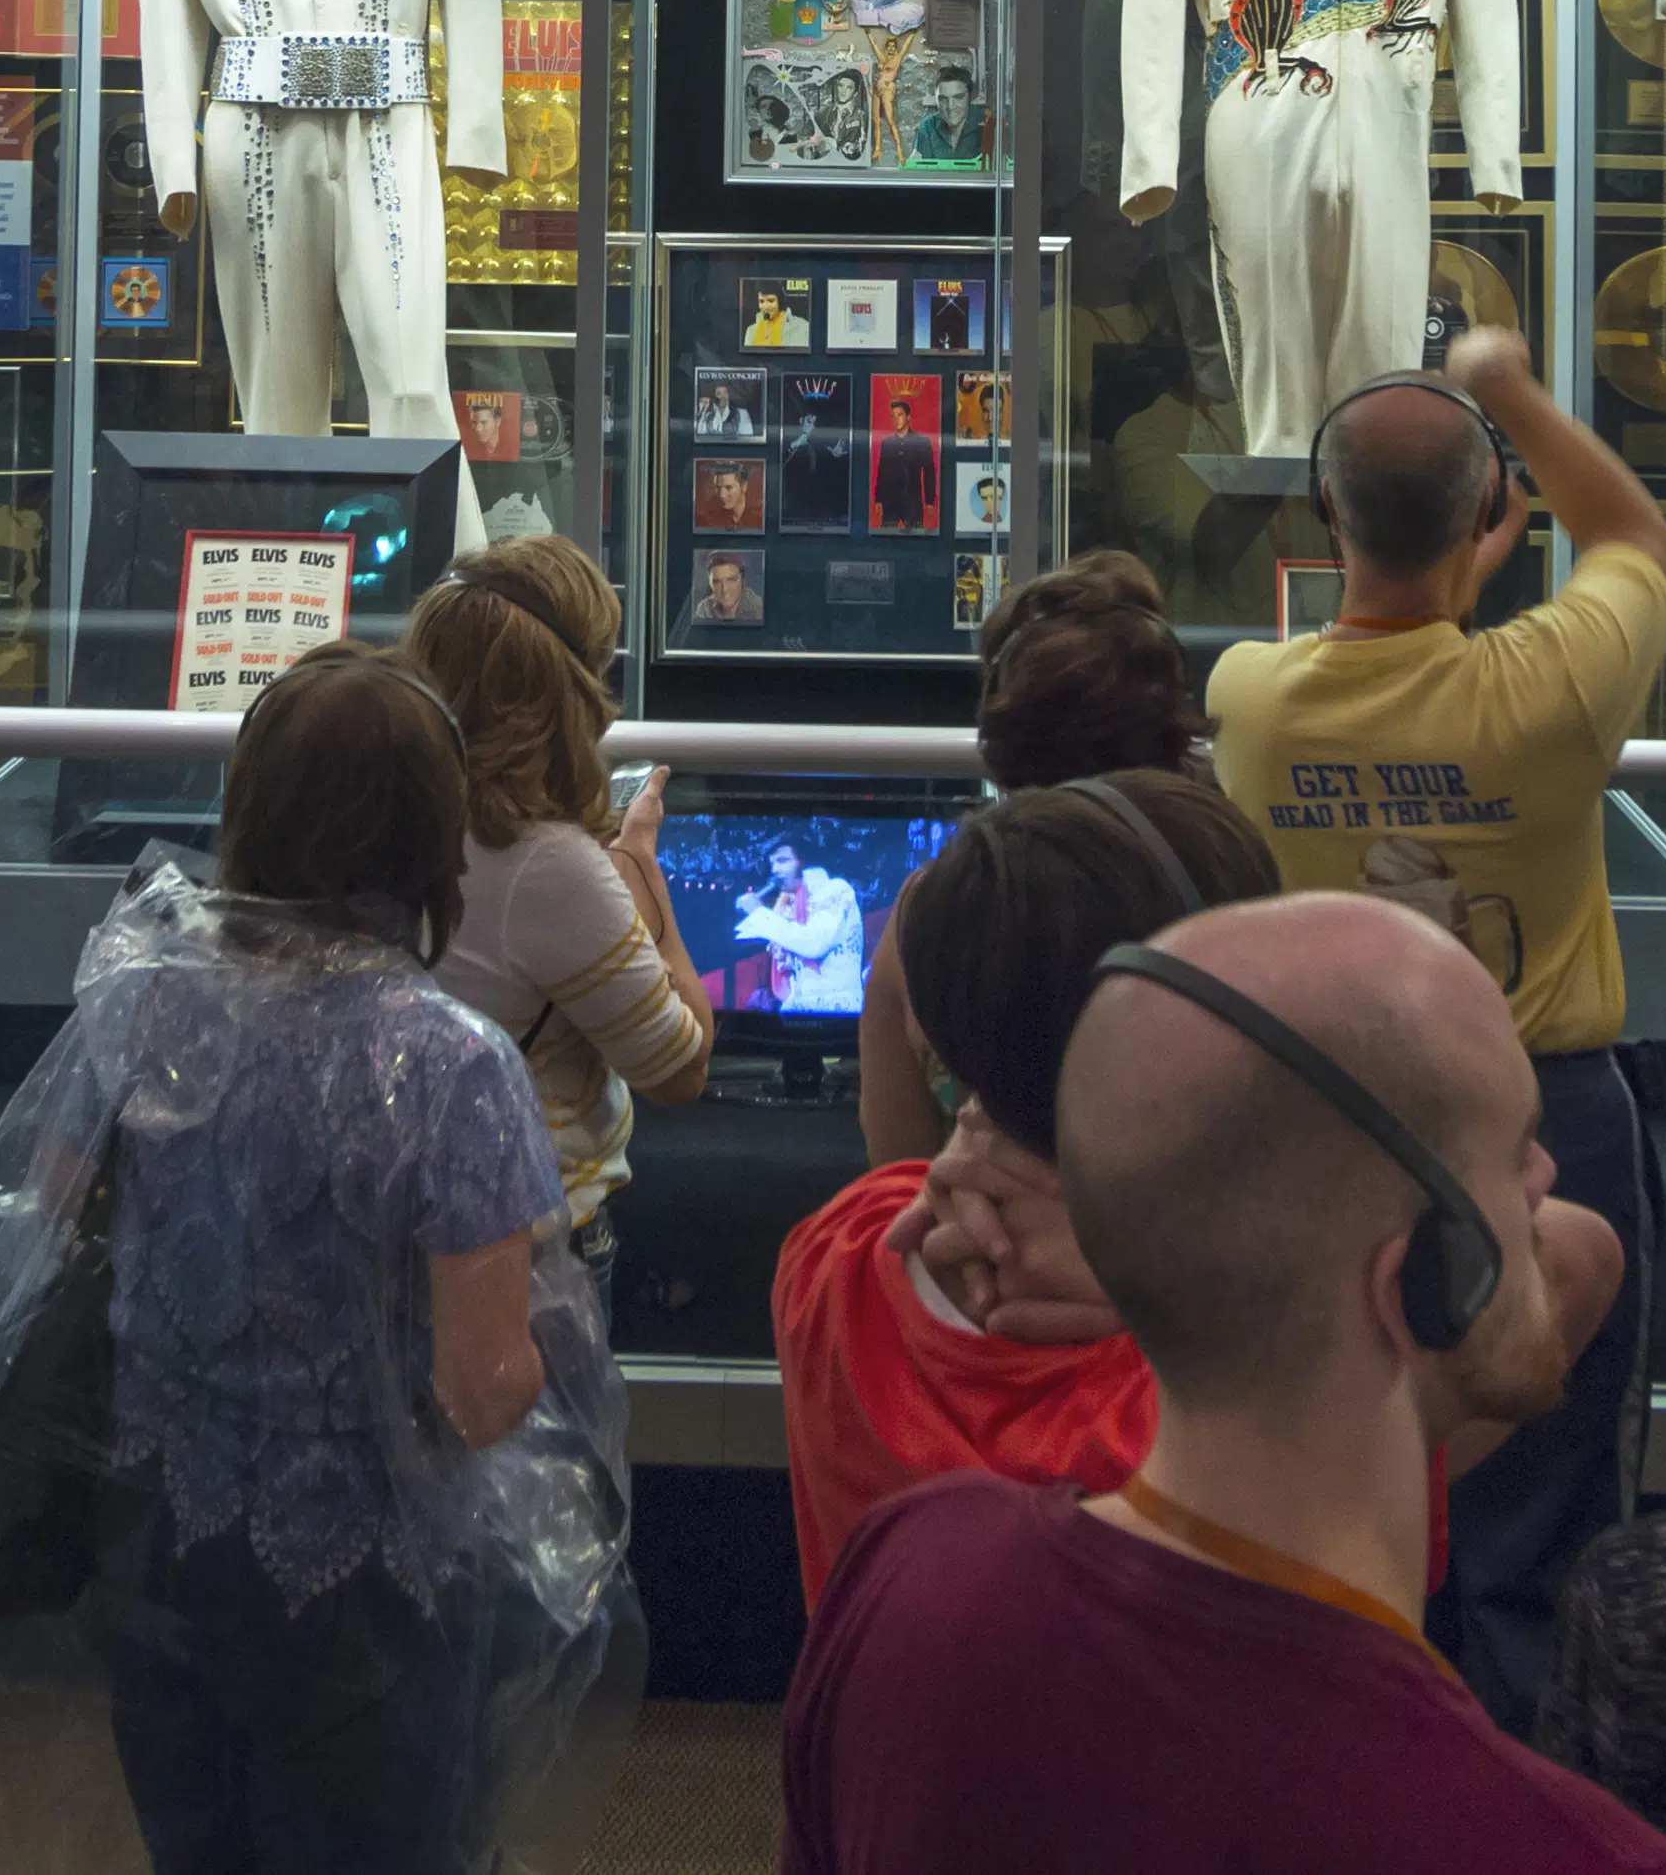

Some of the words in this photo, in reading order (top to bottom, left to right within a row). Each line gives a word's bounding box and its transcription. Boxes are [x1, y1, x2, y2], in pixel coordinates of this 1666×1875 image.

[502, 18, 581, 72] ELVIS
[937, 280, 963, 293] ELVIS
[728, 372, 763, 381] CONCERT
[796, 377, 837, 396] ELVIS
[465, 393, 504, 406] PRESLEY
[202, 548, 239, 565] ELVIS
[250, 548, 288, 563] ELVIS
[299, 550, 337, 569] ELVIS
[203, 592, 222, 605] SOLD
[223, 591, 239, 603] OUT
[247, 591, 265, 602] SOLD
[266, 592, 283, 603] OUT
[289, 593, 308, 606] SOLD
[309, 596, 326, 608] OUT
[196, 609, 232, 626] ELVIS
[245, 608, 281, 623] ELVIS
[293, 611, 330, 630] ELVIS
[196, 644, 215, 656] SOLD
[216, 642, 232, 654] OUT
[241, 653, 260, 664] SOLD
[261, 653, 277, 664] OUT
[189, 670, 226, 687] ELVIS
[238, 670, 276, 686] ELVIS
[1290, 763, 1360, 798] GET
[1372, 763, 1472, 798] YOUR
[1268, 803, 1334, 829] HEAD
[1341, 801, 1370, 829] IN
[1377, 800, 1432, 826] THE
[1436, 797, 1518, 825] GAME
